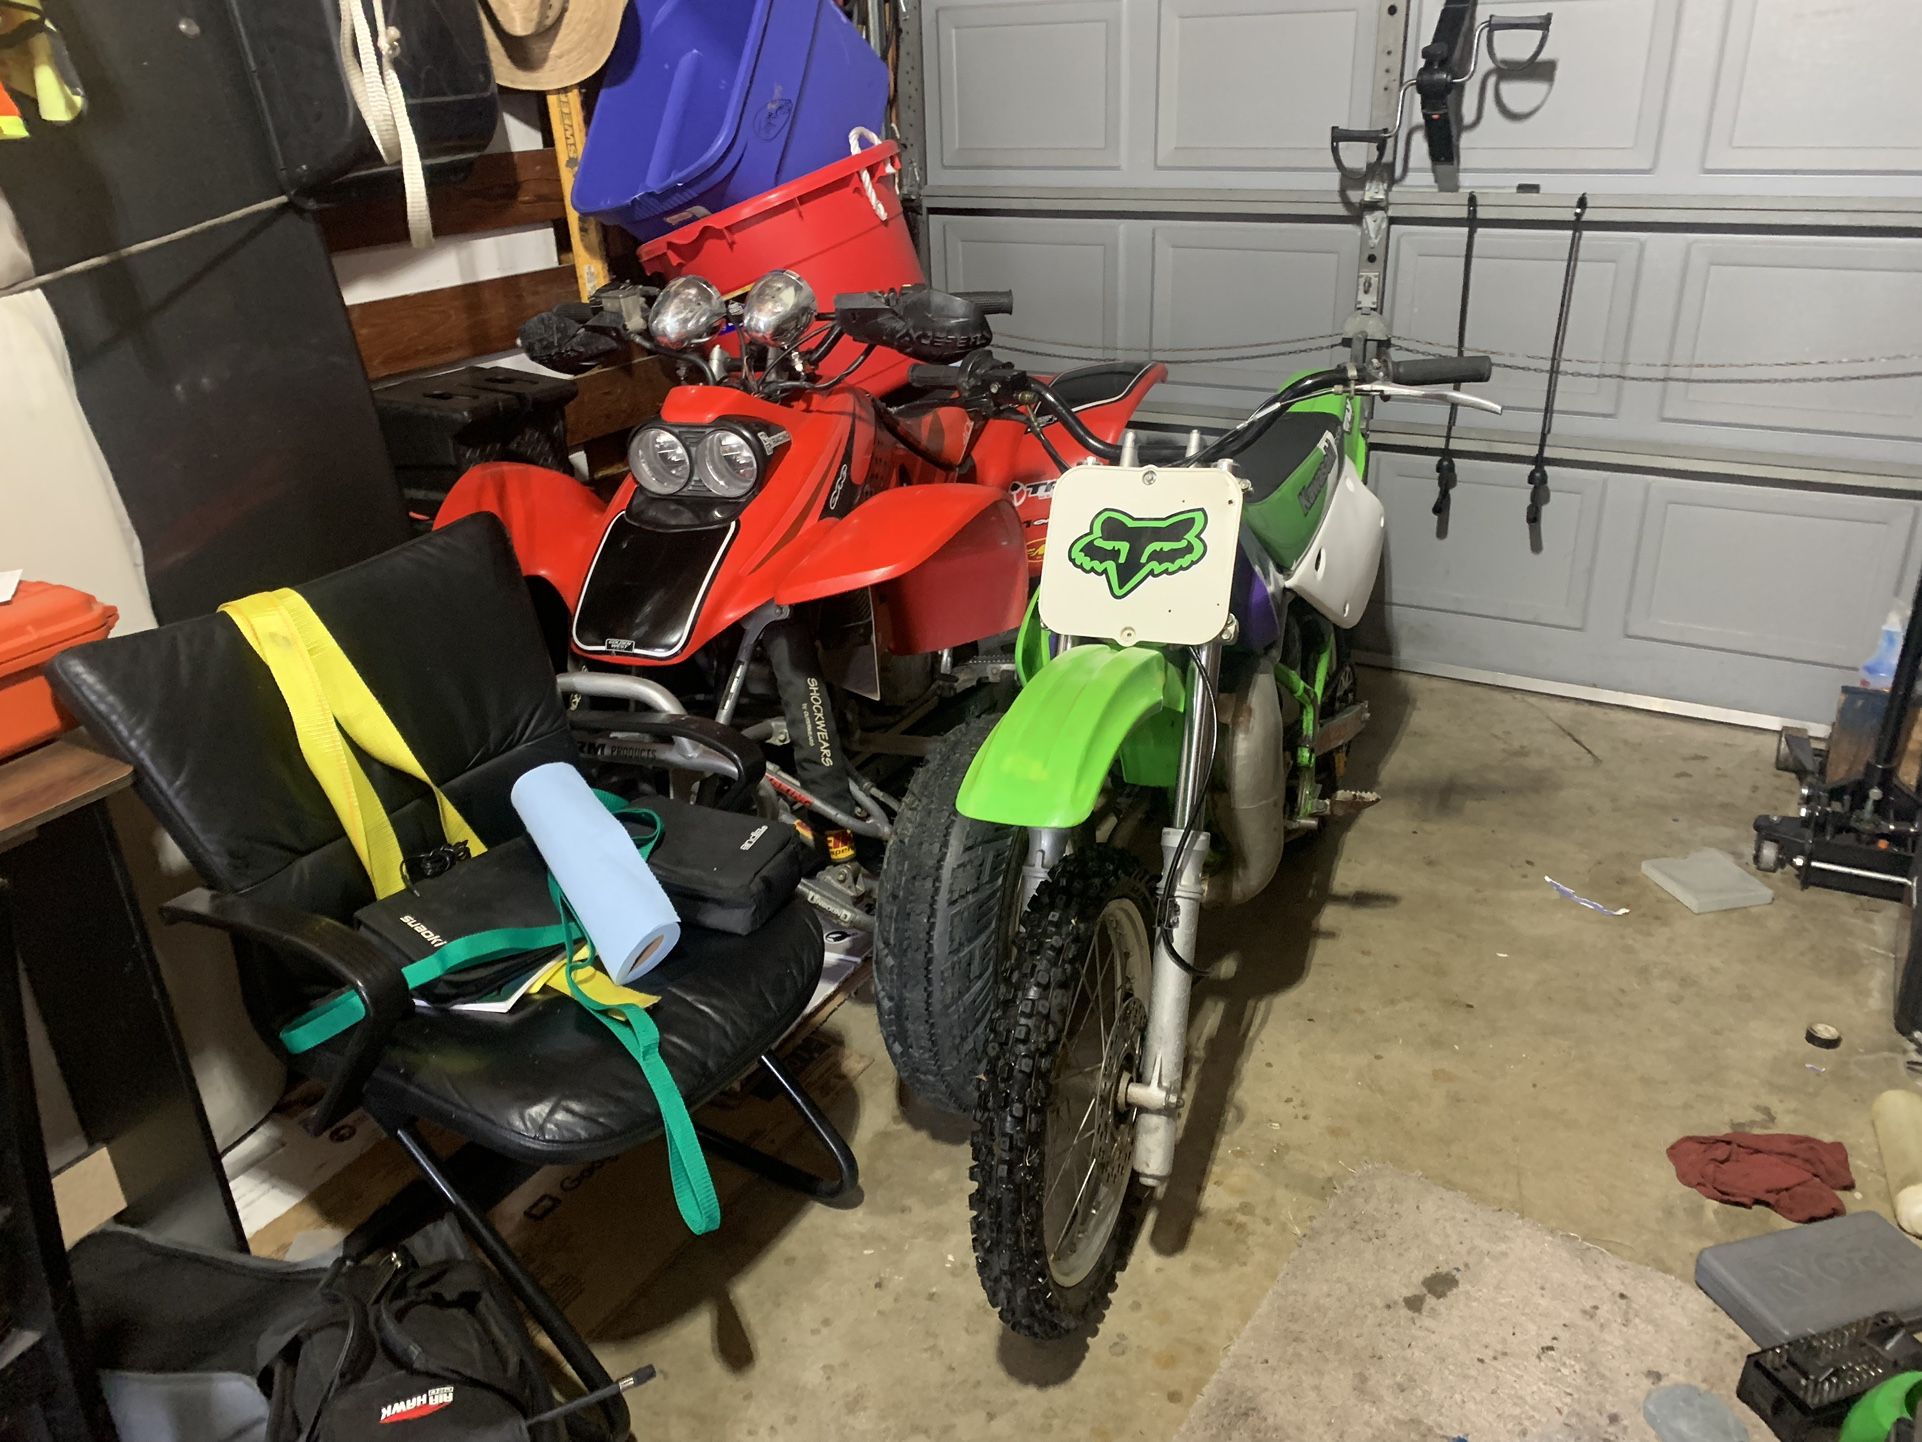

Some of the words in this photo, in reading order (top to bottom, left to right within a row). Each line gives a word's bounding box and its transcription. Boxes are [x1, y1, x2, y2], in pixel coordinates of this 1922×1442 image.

[807, 677, 833, 767] SHOCKWEARS
[400, 915, 447, 947] suaoki
[380, 1393, 427, 1421] HAWK
